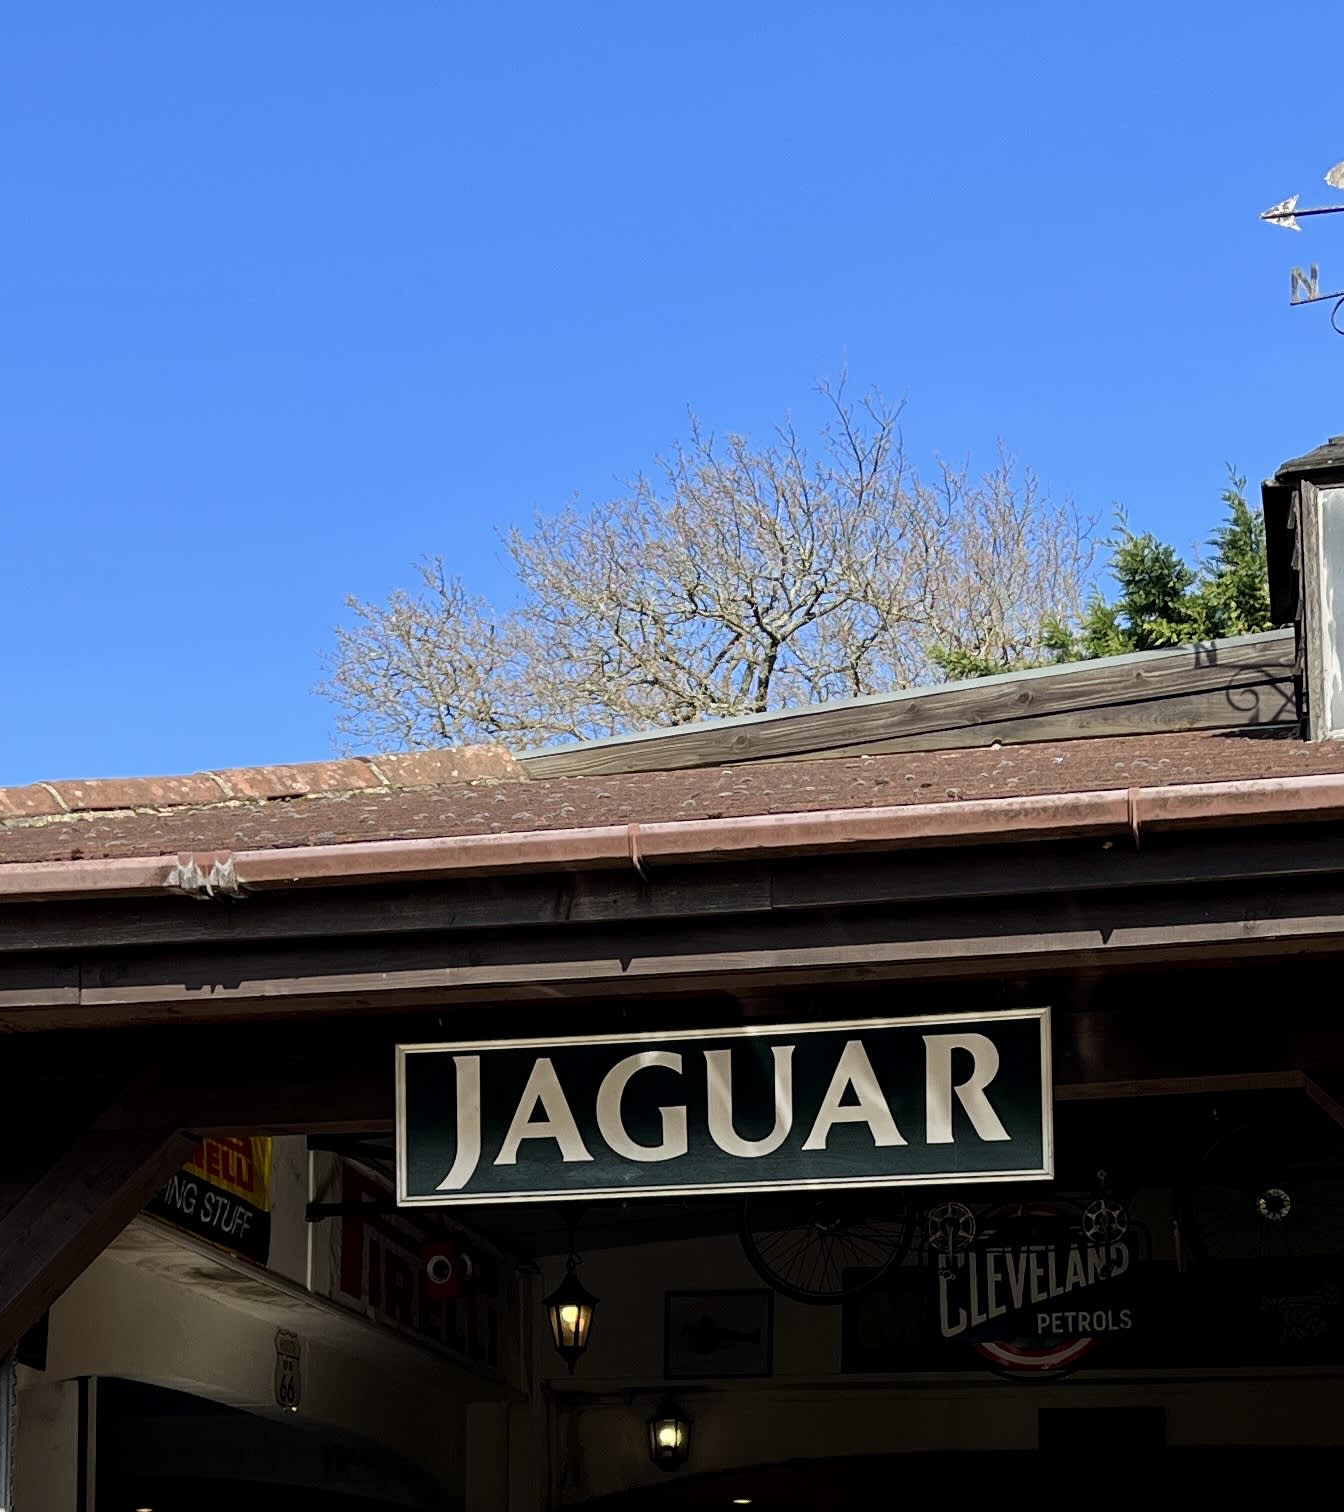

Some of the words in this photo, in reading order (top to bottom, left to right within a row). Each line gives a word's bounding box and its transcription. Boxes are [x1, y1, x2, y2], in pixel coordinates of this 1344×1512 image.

[1291, 264, 1319, 303] N
[435, 1032, 1012, 1192] JAGUAR
[164, 1175, 198, 1216] ING
[200, 1191, 254, 1240] STUFF
[939, 1242, 1130, 1339] CLEVELAND
[1037, 1308, 1133, 1335] PETROLS
[280, 1375, 295, 1403] 66
